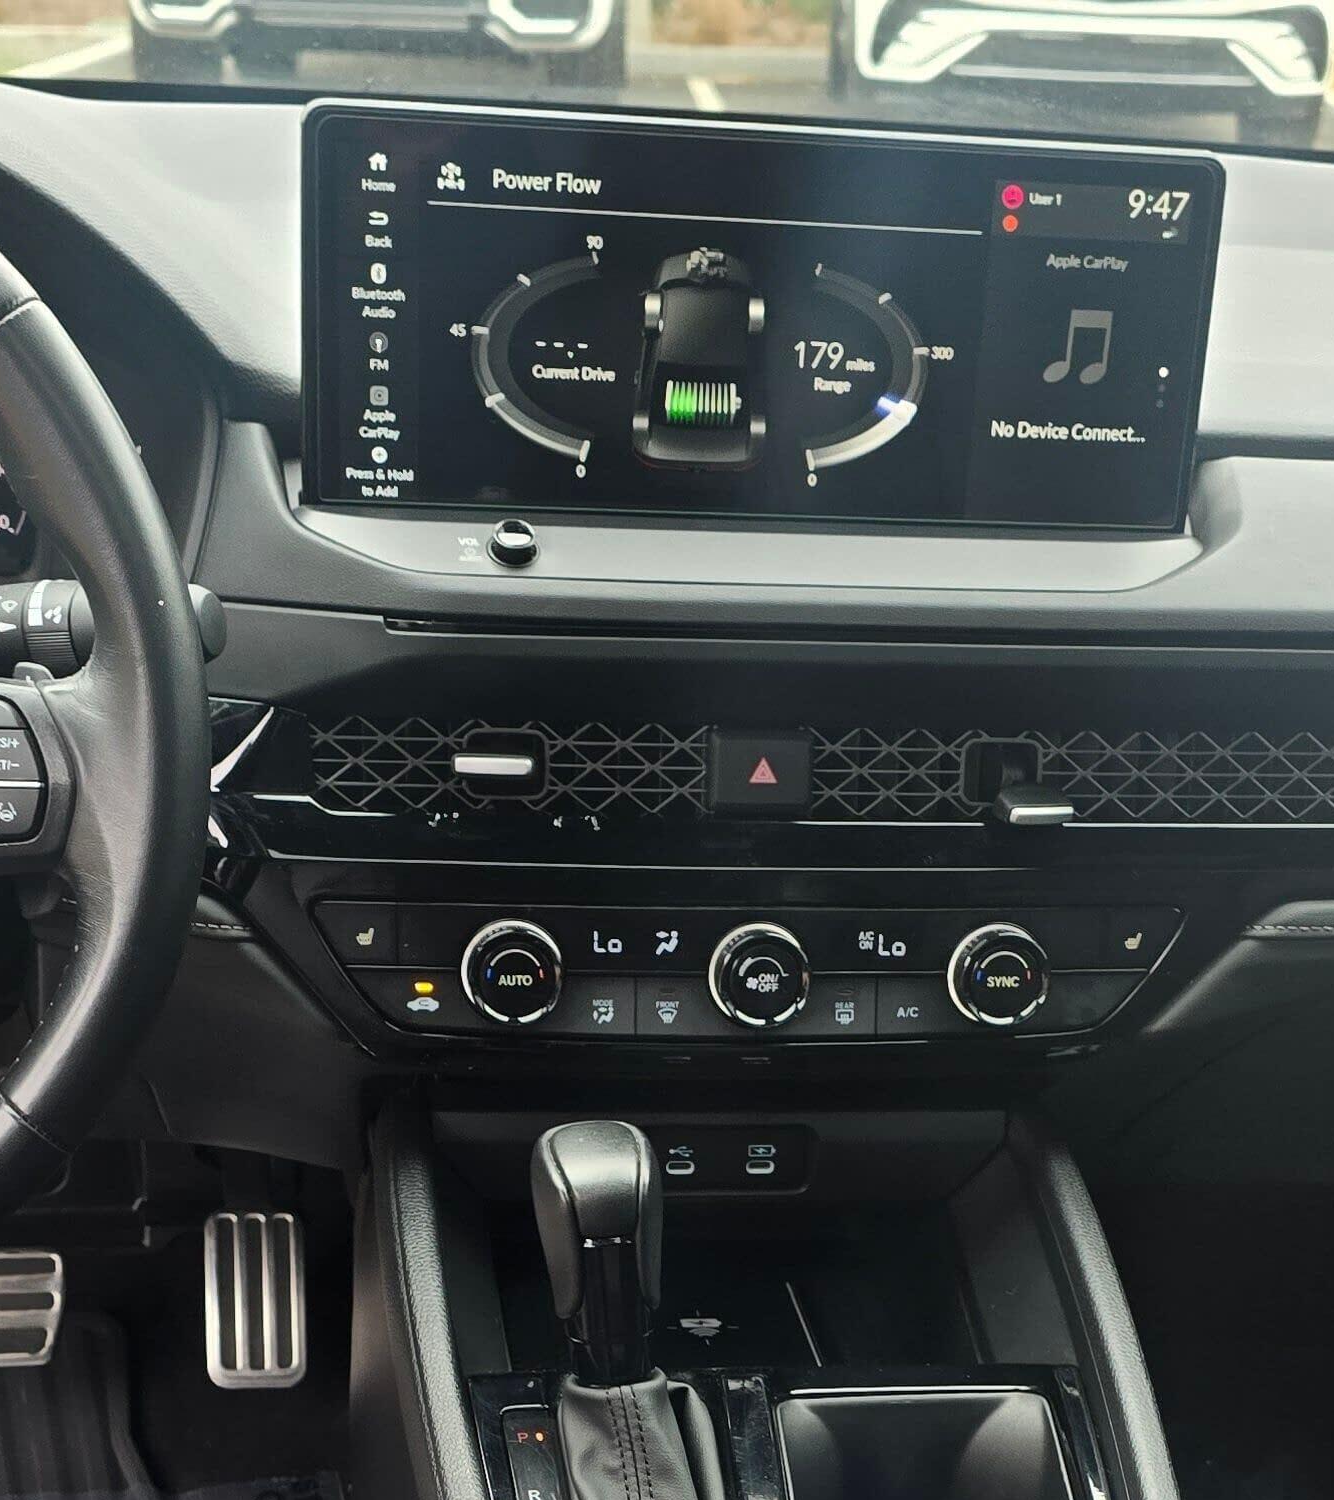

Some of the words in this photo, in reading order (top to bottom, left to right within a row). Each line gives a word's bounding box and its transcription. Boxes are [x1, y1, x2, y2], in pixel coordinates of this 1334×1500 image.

[361, 178, 397, 193] Home
[492, 168, 553, 192] Power
[555, 172, 602, 195] Flow
[1028, 192, 1054, 206] User
[1128, 188, 1191, 221] 9:47
[364, 234, 393, 249] Back
[586, 235, 604, 250] 90
[1045, 253, 1082, 270] Apple
[1083, 254, 1129, 273] CarPlay
[351, 286, 406, 302] Bluetooth
[361, 305, 397, 319] Audio
[449, 323, 467, 338] 45
[794, 340, 845, 370] 179
[845, 357, 876, 373] miles
[369, 358, 390, 372] FM
[531, 363, 580, 381] Current
[581, 366, 616, 382] Drive
[813, 376, 852, 395] Range
[363, 408, 397, 424] Apple
[358, 425, 401, 442] CarPlay
[990, 419, 1015, 438] No
[1016, 420, 1070, 440] Device
[1070, 422, 1146, 443] Connect...
[345, 466, 375, 481] Press
[375, 468, 386, 481] &
[386, 468, 415, 482] Hold
[575, 463, 587, 479] 0
[807, 472, 818, 487] 0
[361, 485, 375, 497] to
[374, 485, 399, 498] Add
[593, 930, 623, 954] Lo
[857, 929, 876, 942] A/C
[857, 940, 875, 952] ON
[877, 933, 907, 957] Lo
[497, 974, 533, 987] AUTO
[757, 972, 779, 983] ON/
[986, 975, 1020, 988] SYNC
[757, 982, 779, 993] OFF
[592, 999, 614, 1009] MODE
[655, 1000, 680, 1011] FRONT
[834, 1001, 855, 1012] REAR
[896, 1006, 919, 1018] A/C
[516, 1431, 530, 1444] P
